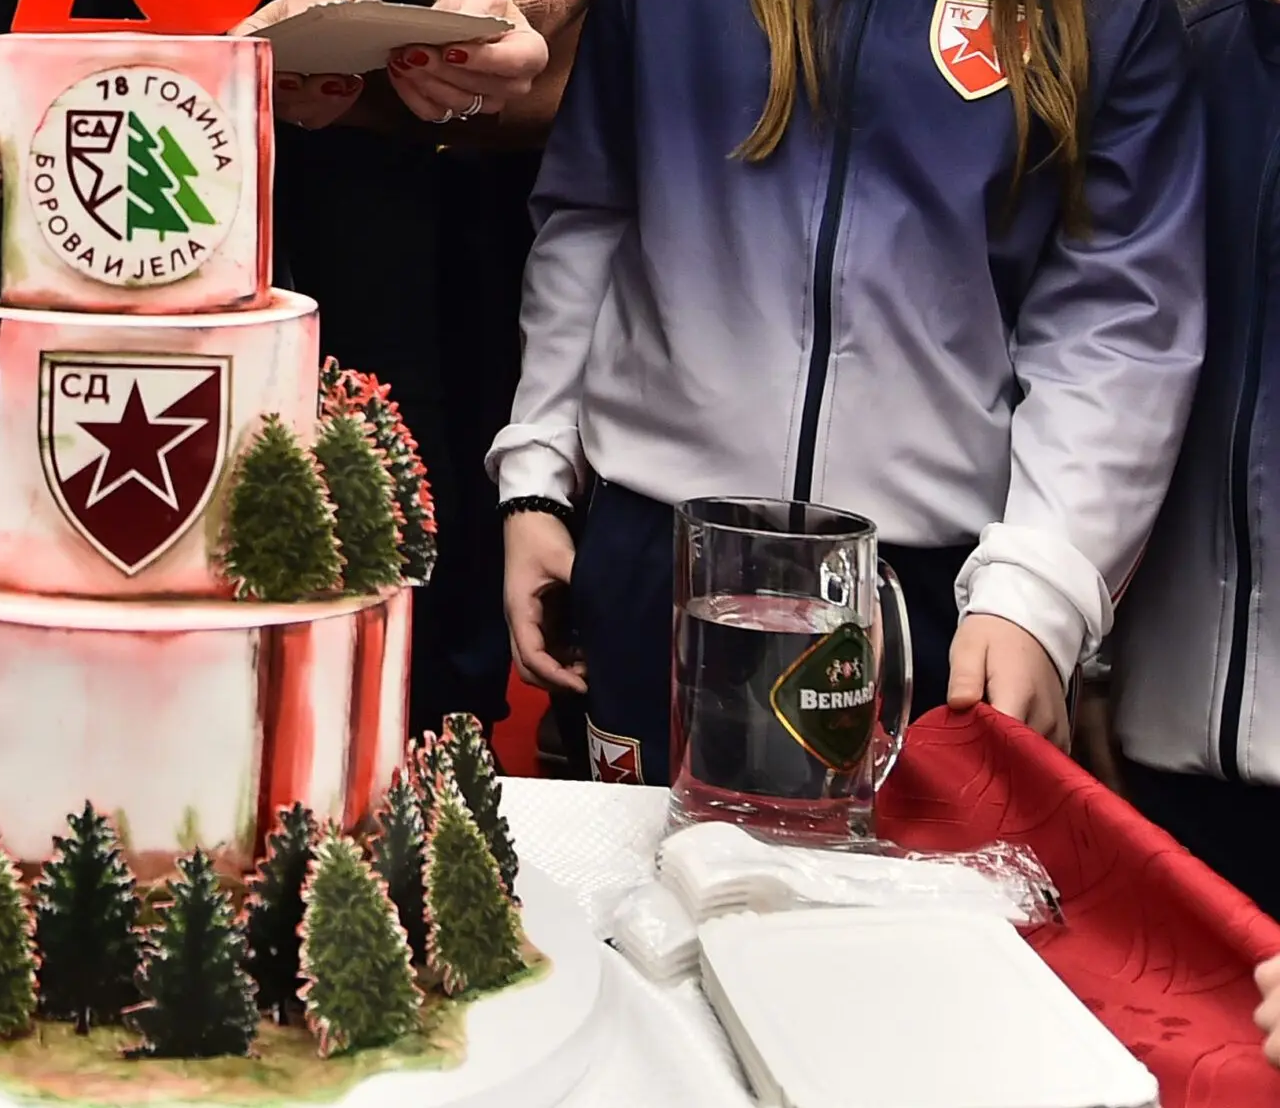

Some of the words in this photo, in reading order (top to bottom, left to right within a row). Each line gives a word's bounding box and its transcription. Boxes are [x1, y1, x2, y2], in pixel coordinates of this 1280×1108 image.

[73, 118, 112, 138] СД
[96, 76, 130, 101] 78
[144, 75, 233, 172] ГОДИНА
[34, 153, 96, 268] БОРОВА
[103, 254, 125, 278] И
[132, 238, 207, 280] ЈЕЛА
[60, 373, 110, 405] СД
[800, 680, 876, 710] BERNARD
